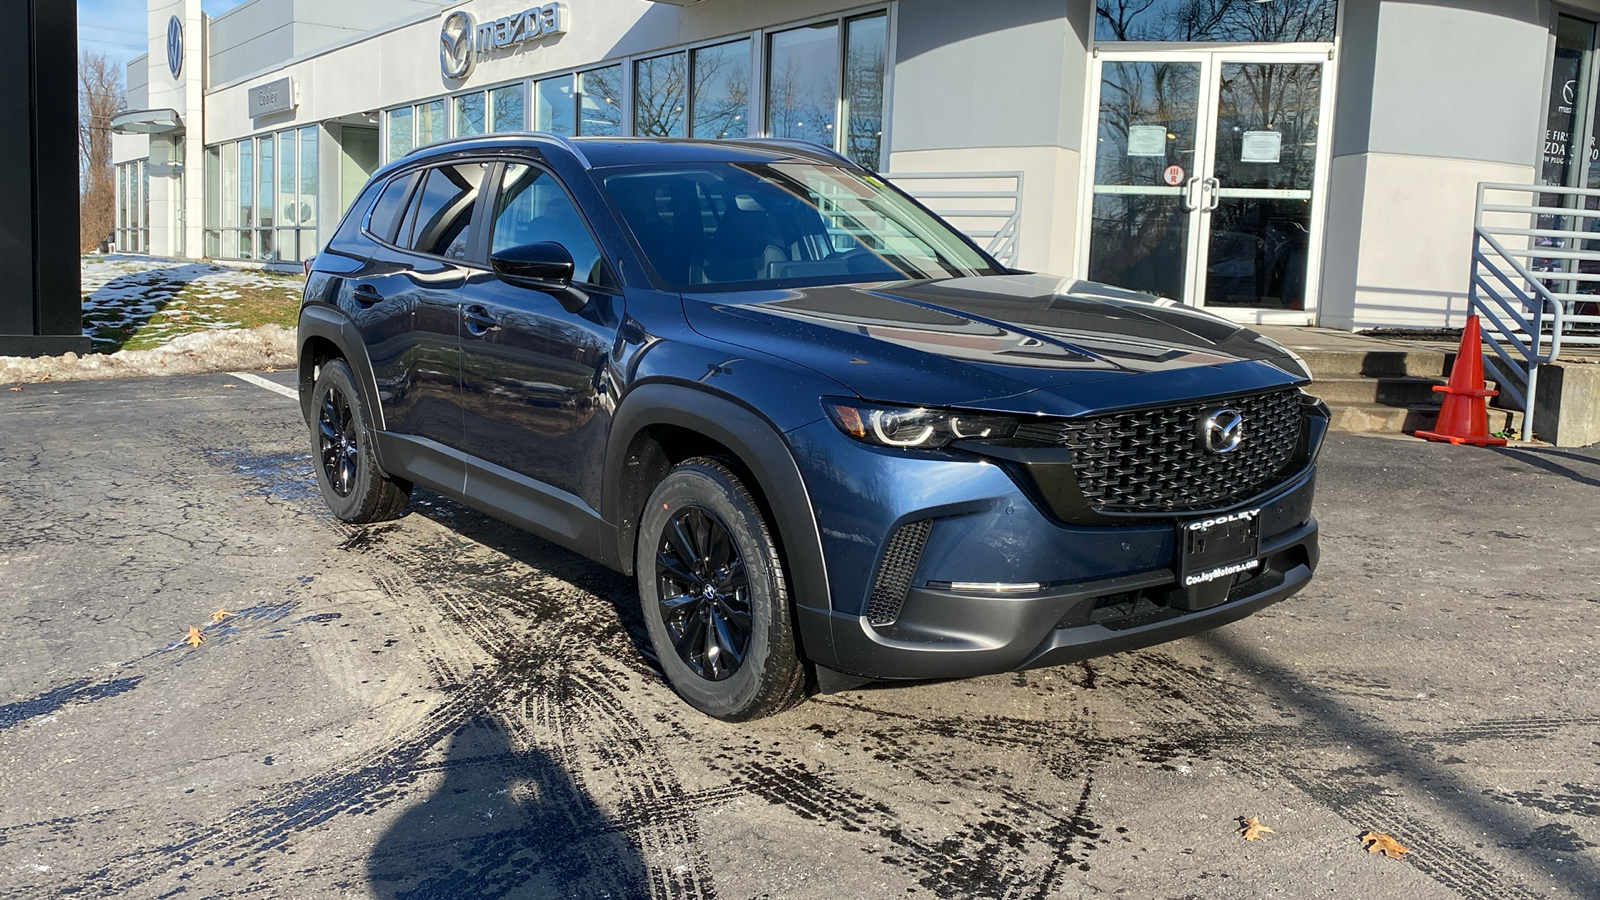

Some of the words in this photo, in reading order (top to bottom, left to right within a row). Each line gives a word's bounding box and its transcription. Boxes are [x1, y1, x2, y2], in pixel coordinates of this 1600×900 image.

[475, 2, 563, 53] mazda
[258, 86, 278, 108] Cooley
[1544, 141, 1566, 156] ZDA
[1170, 175, 1177, 183] R
[1185, 559, 1259, 586] CooleyMotors.com
